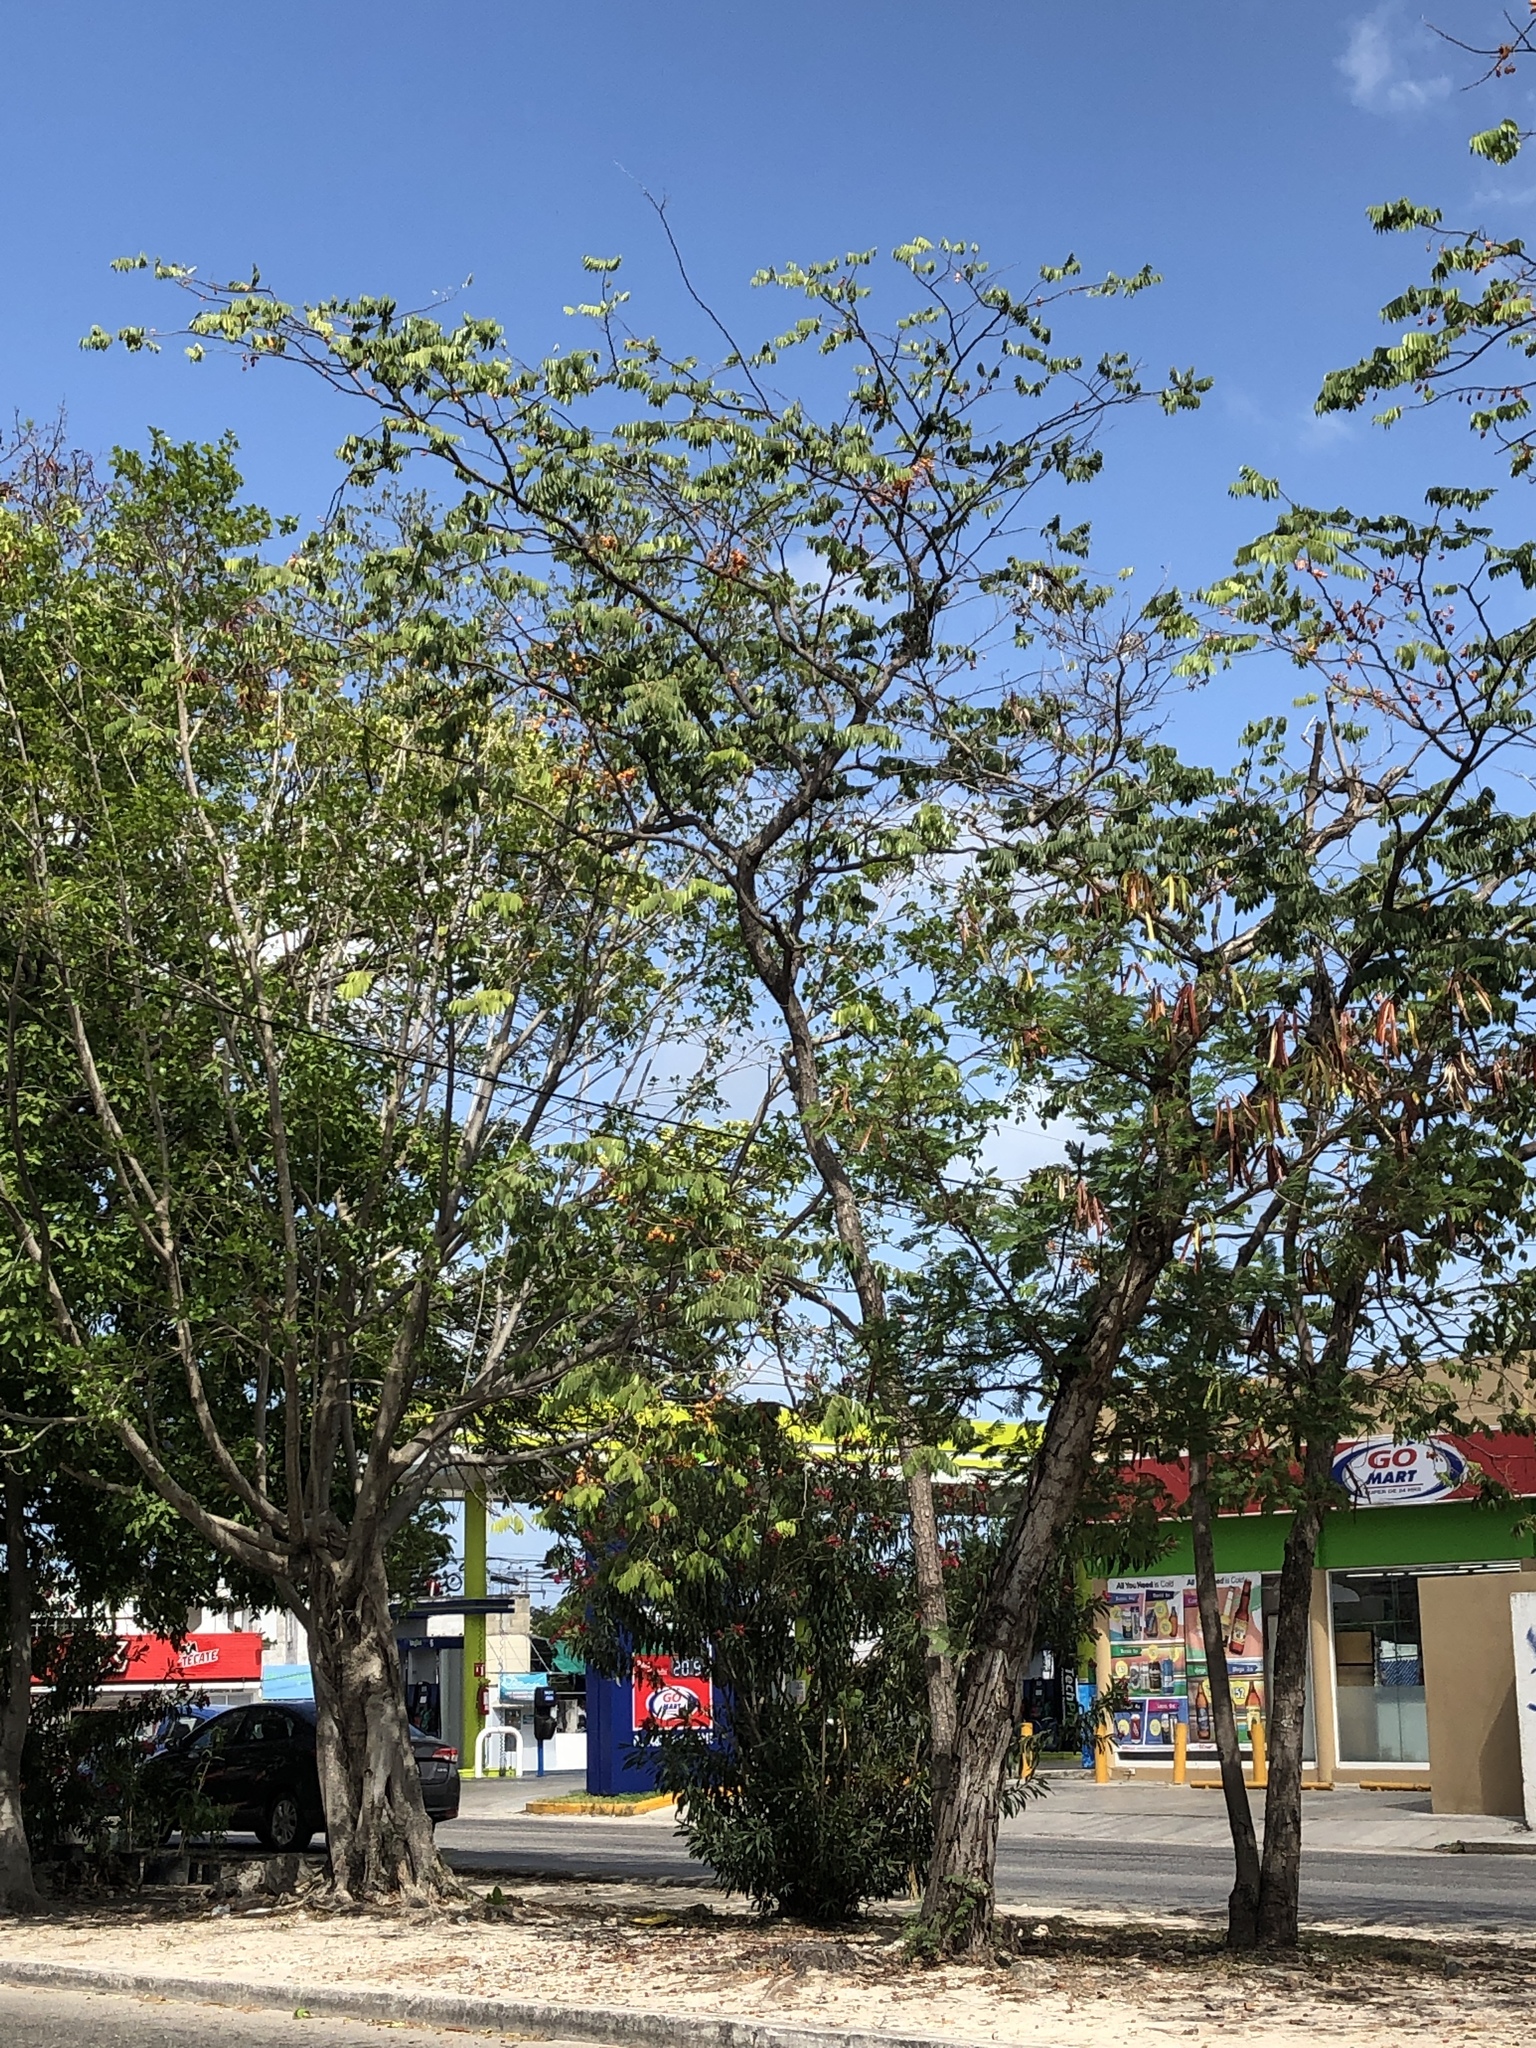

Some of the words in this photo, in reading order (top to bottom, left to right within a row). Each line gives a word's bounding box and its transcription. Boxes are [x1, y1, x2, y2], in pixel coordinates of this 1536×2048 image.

[1367, 1448, 1417, 1469] GO
[1366, 1470, 1418, 1485] MART
[1116, 1582, 1125, 1590] All
[1125, 1581, 1137, 1590] You
[1137, 1580, 1154, 1589] Need
[1154, 1580, 1160, 1588] is
[1160, 1579, 1175, 1588] Cold
[181, 1649, 218, 1667] TECATE
[662, 1693, 681, 1703] GO
